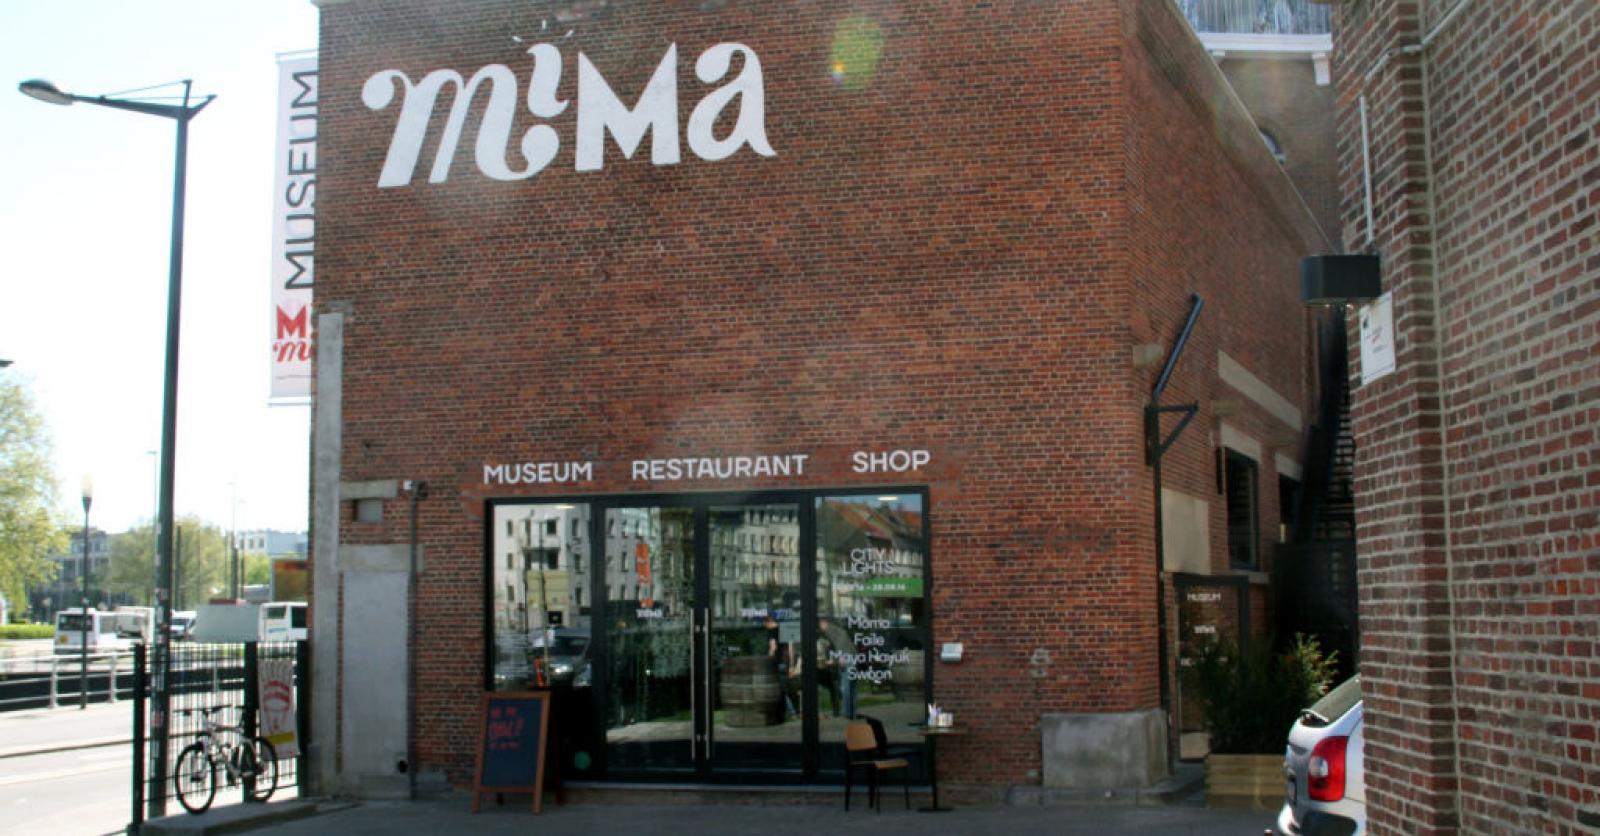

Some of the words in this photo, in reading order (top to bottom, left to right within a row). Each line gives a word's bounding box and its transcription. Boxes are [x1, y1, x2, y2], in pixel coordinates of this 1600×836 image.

[483, 462, 593, 484] MUSEUM
[632, 454, 808, 480] RESTAURANT
[852, 450, 931, 473] SHOP
[851, 548, 885, 562] CITY
[843, 561, 894, 575] LIGHTS
[855, 633, 885, 646] Faile
[829, 650, 866, 665] Maya
[868, 648, 910, 667] Hayuk
